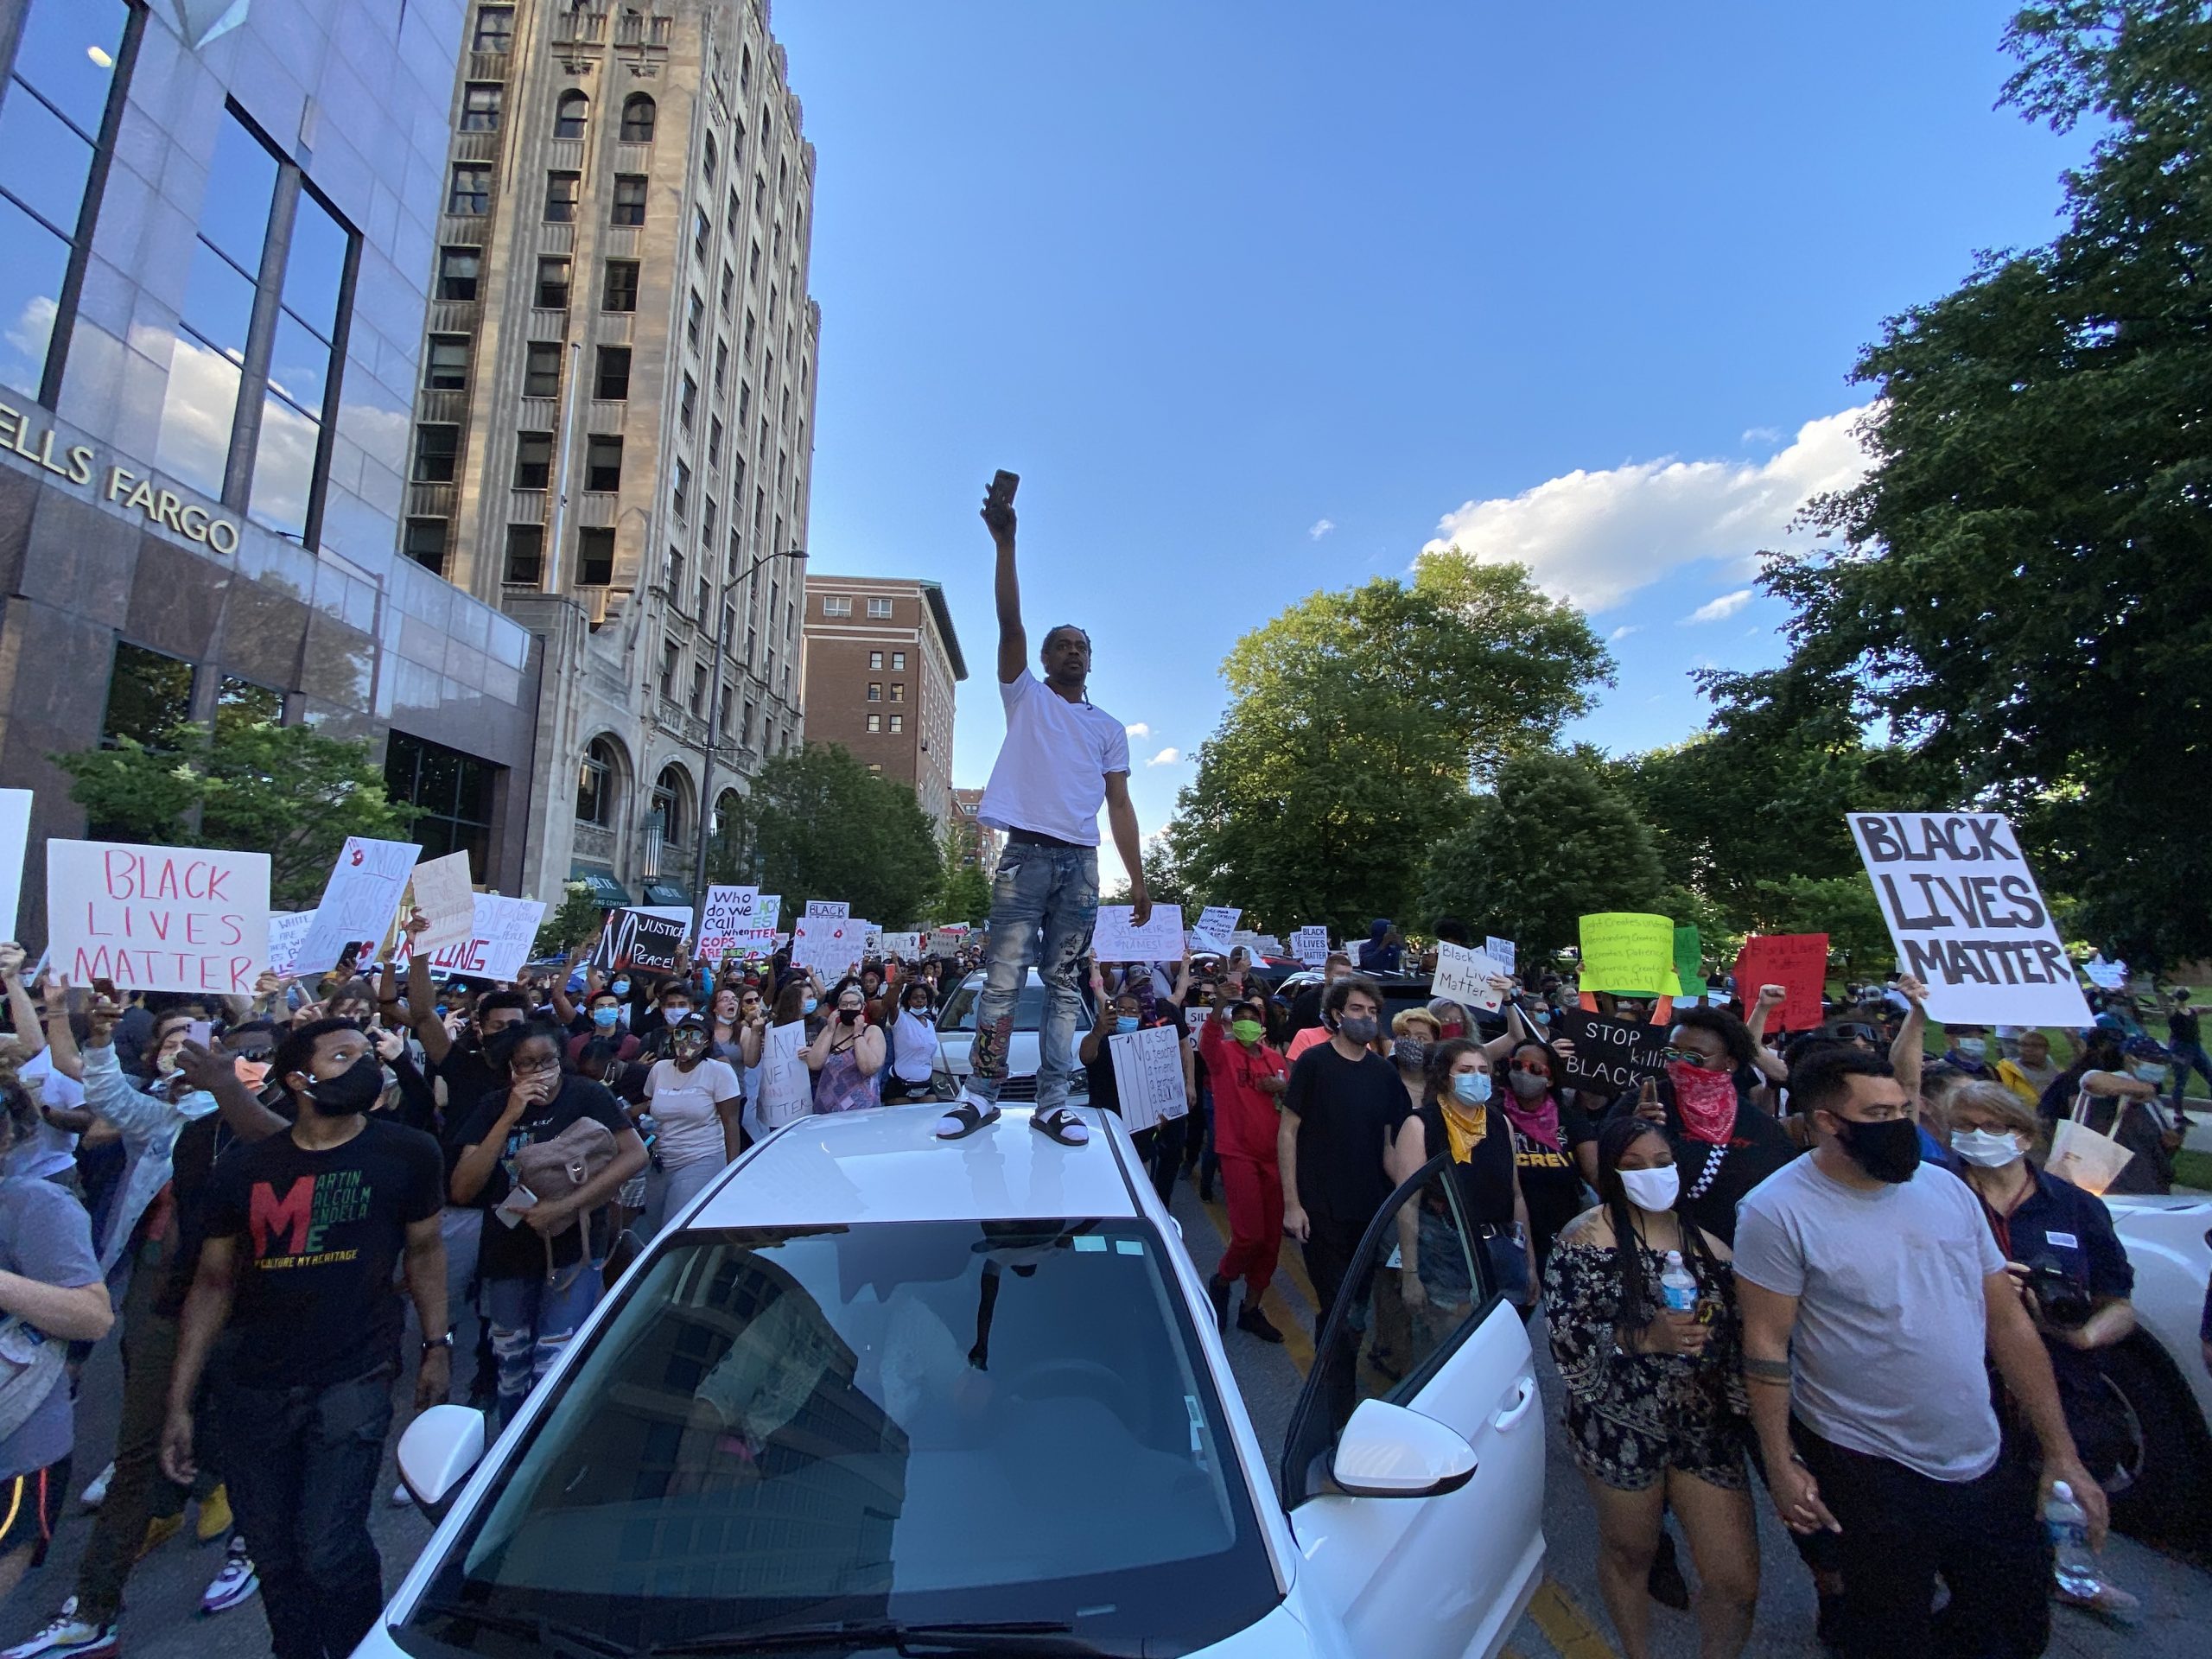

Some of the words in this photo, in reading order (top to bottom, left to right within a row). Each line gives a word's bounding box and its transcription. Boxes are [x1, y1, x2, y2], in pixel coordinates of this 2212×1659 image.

[106, 467, 238, 554] FARGO
[1857, 817, 2019, 862] BLACK
[105, 849, 231, 901] BLACK
[707, 905, 725, 917] do
[714, 892, 751, 903] Who
[810, 905, 845, 915] BLACK
[1879, 874, 2045, 931] LIVES
[88, 902, 244, 945] LIVES
[639, 918, 685, 938] JUSTICE
[699, 948, 721, 958] ARE
[701, 937, 735, 948] COPS
[1442, 944, 1474, 963] Black
[74, 945, 251, 995] MATTER
[1901, 938, 2071, 984] MATTER
[1585, 1022, 1641, 1046] STOP
[1567, 1056, 1641, 1088] BLACK
